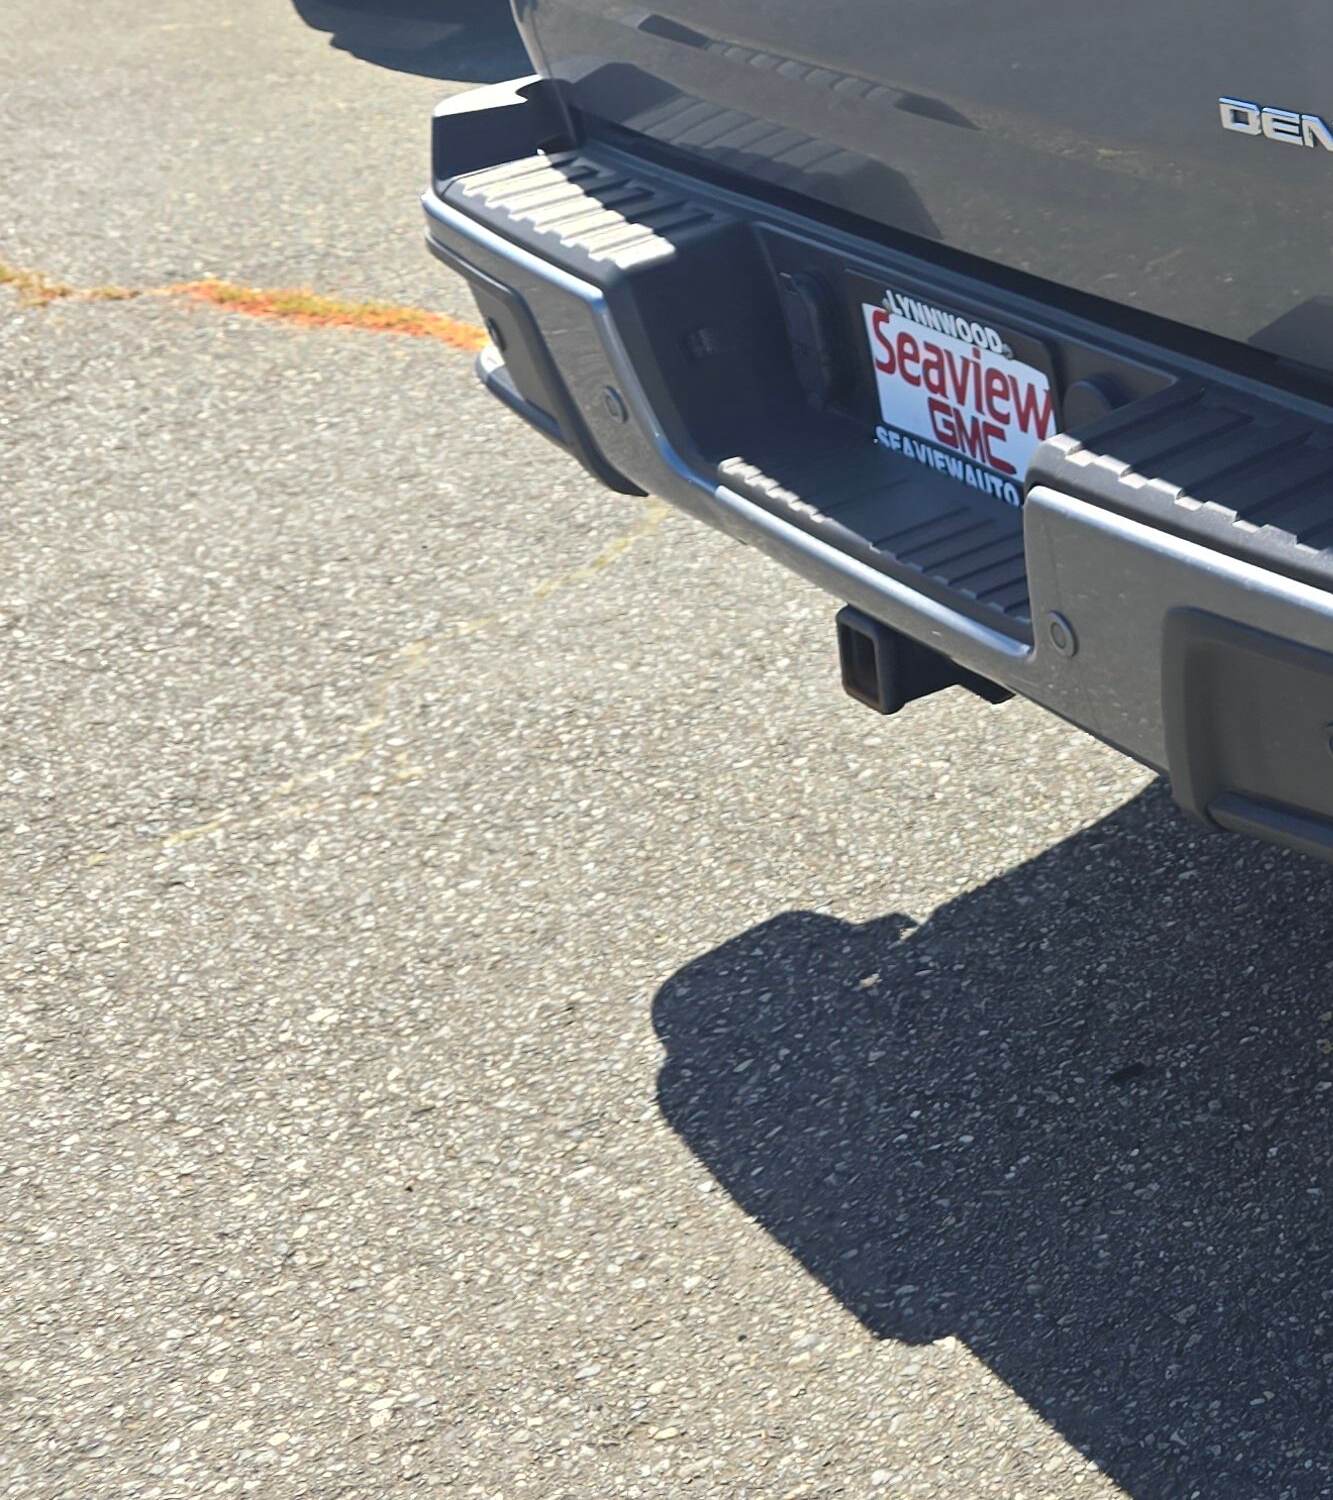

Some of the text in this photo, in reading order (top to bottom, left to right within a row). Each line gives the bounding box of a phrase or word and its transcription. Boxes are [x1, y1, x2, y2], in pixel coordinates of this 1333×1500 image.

[885, 289, 1003, 353] LYNNWOOD
[872, 309, 1052, 441] Seaview
[927, 396, 1017, 475] GMC
